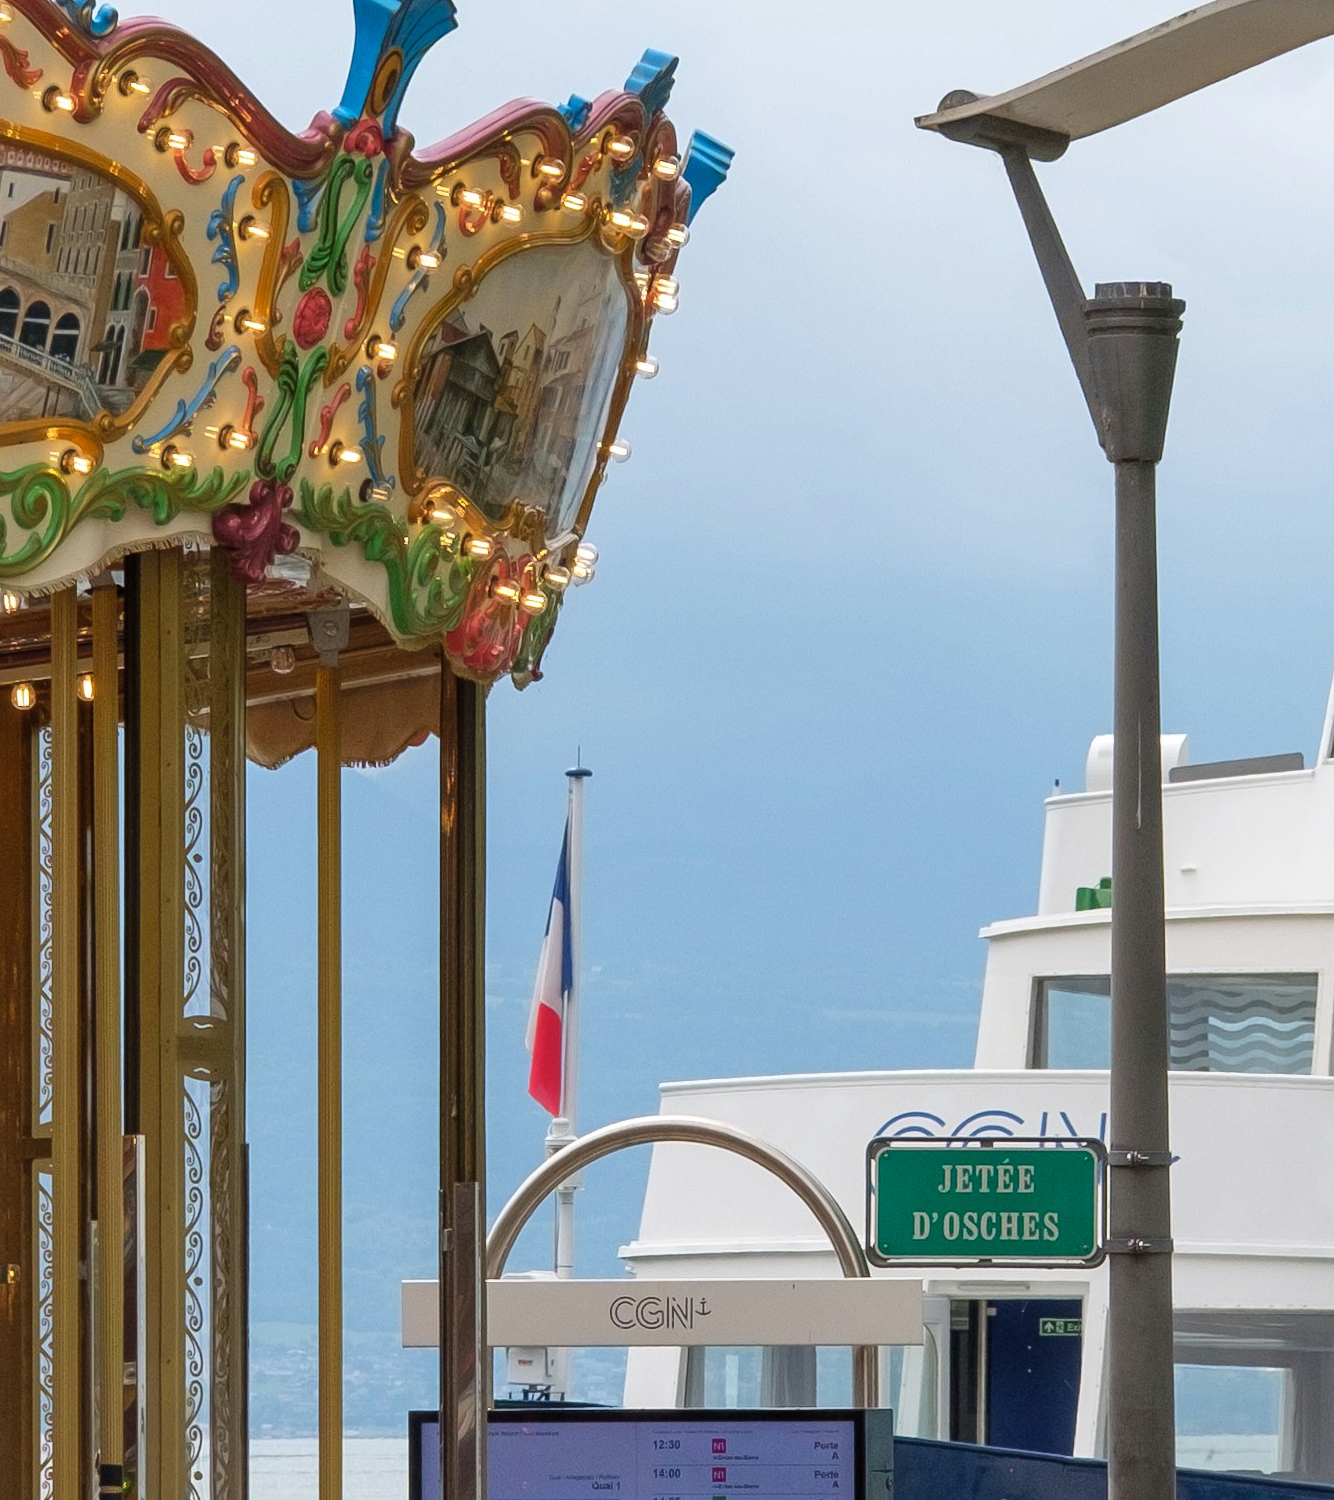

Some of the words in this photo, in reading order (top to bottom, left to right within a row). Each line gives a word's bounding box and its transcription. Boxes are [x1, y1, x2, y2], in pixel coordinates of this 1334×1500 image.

[937, 1157, 1035, 1194] JETÉE
[912, 1211, 1060, 1242] D'OSCHES
[609, 1296, 694, 1330] CGN
[652, 1440, 681, 1450] 12:30
[831, 1452, 839, 1460] A
[652, 1468, 681, 1479] 14:00
[591, 1482, 614, 1490] Quai
[832, 1481, 839, 1489] A
